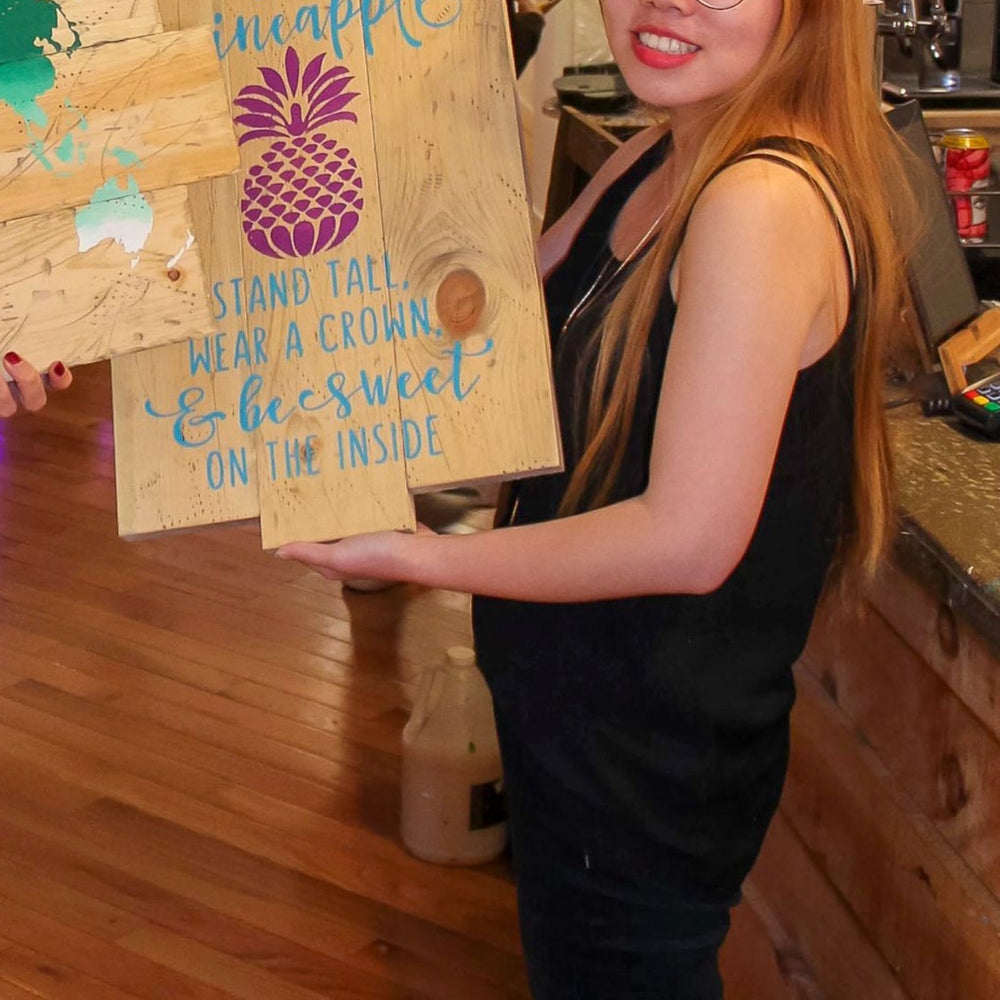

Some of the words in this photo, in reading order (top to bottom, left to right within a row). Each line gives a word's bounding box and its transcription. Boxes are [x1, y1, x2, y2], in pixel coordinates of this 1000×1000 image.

[211, 266, 310, 321] STAND
[187, 327, 269, 378] WEAR
[285, 320, 304, 360] A
[145, 386, 227, 449] &
[238, 373, 297, 433] be
[298, 337, 495, 421] sweet
[206, 447, 249, 491] ON
[265, 434, 321, 482] THE
[337, 414, 445, 472] INSIDE
